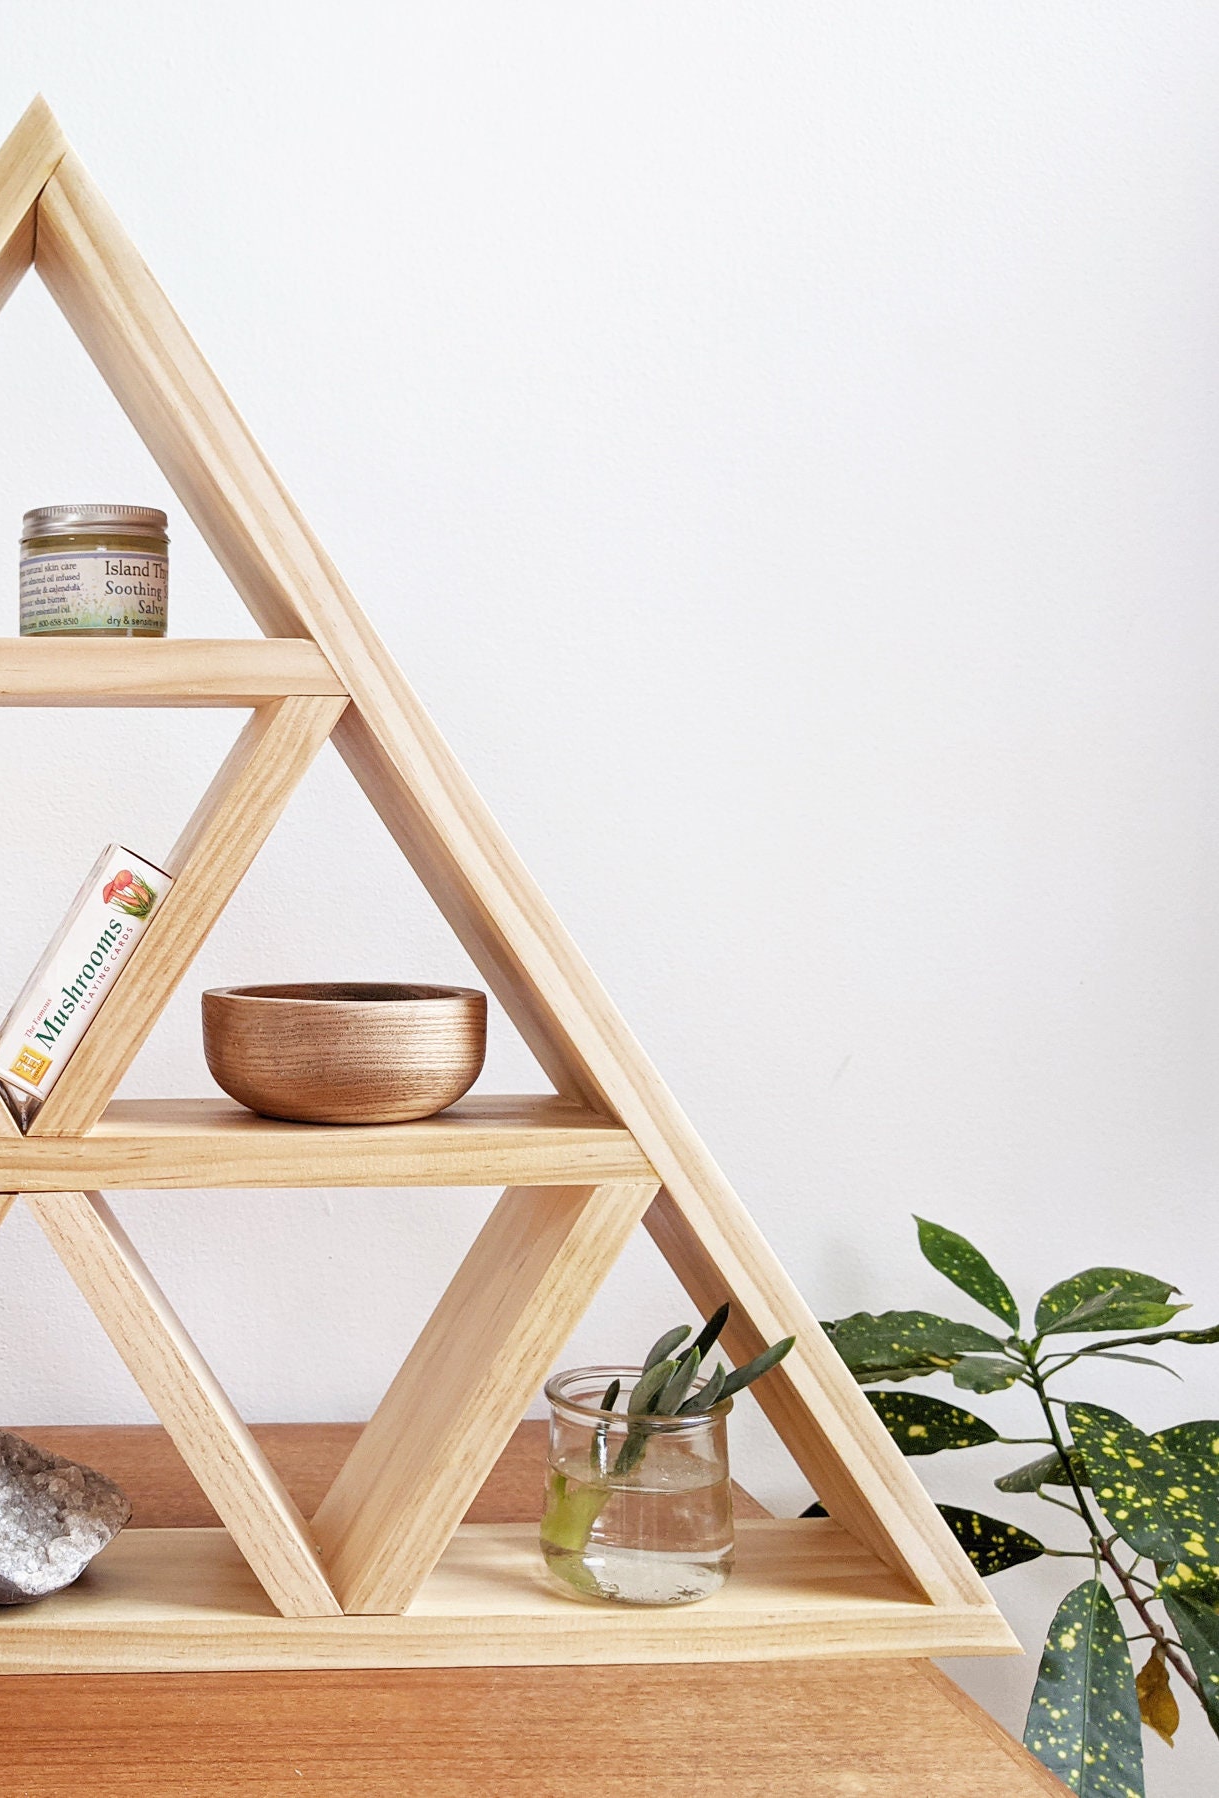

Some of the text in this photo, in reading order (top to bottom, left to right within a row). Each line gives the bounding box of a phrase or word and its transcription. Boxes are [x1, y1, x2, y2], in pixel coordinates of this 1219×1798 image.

[44, 562, 60, 573] skin
[60, 563, 77, 571] care
[105, 560, 150, 577] Island
[46, 573, 55, 583] oil
[55, 572, 81, 582] infused
[42, 586, 48, 594] &
[105, 580, 162, 602] Soothing
[138, 600, 164, 616] Salve
[106, 615, 122, 627] dry
[123, 615, 130, 625] &
[80, 926, 134, 1011] PLAYING CARDS
[34, 918, 123, 1051] Mushrooms
[24, 998, 53, 1038] The Famous
